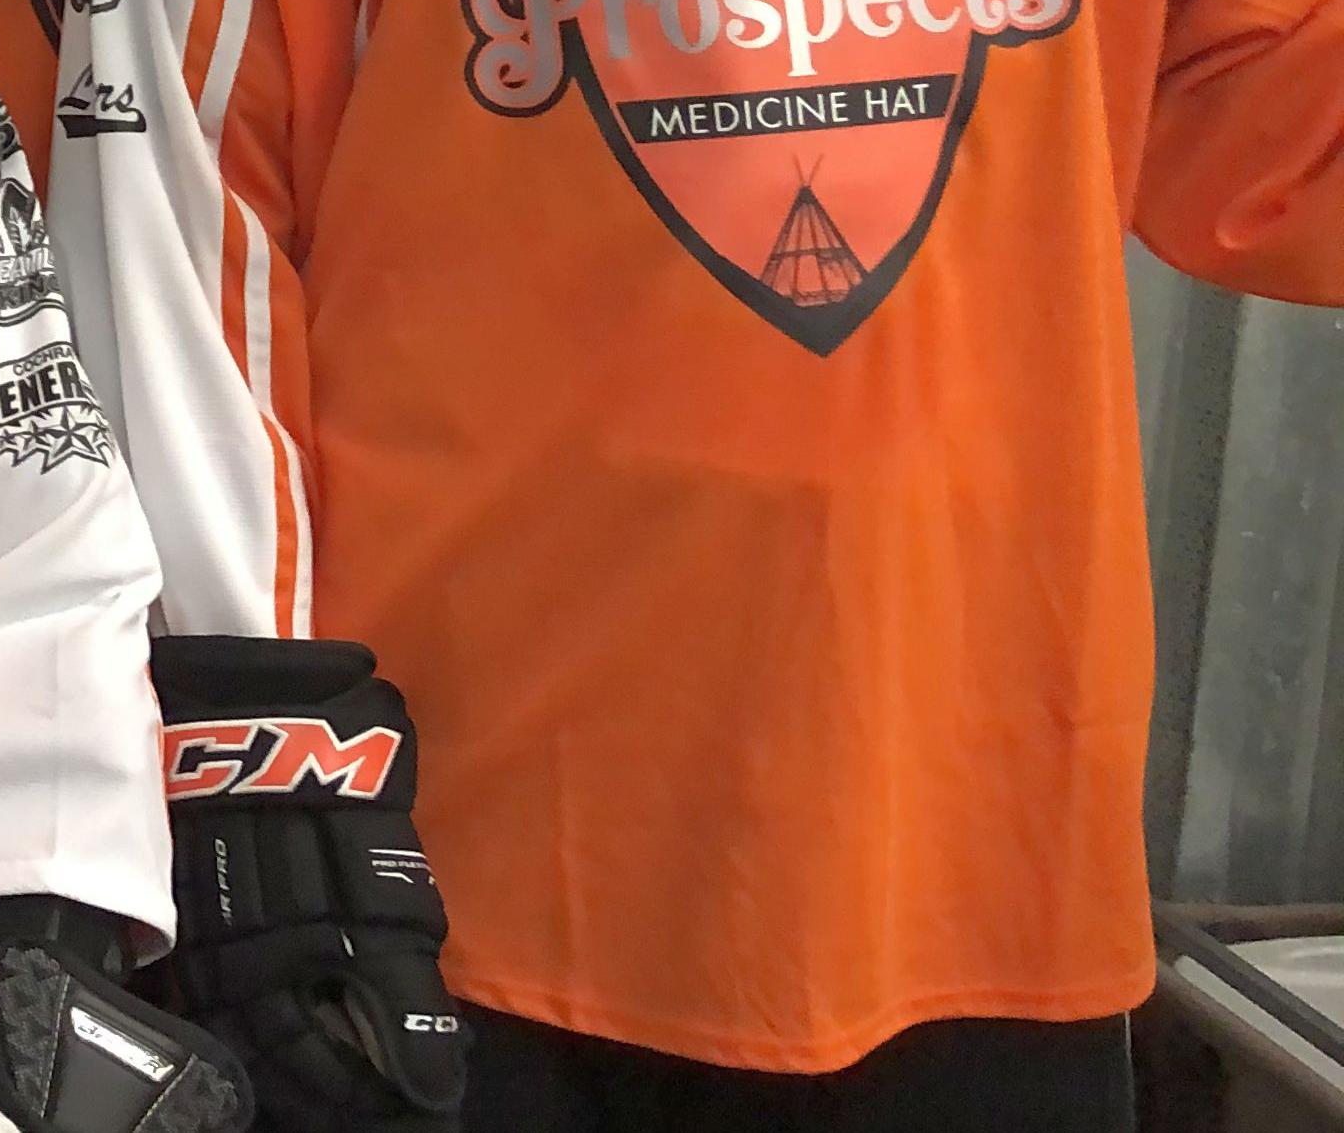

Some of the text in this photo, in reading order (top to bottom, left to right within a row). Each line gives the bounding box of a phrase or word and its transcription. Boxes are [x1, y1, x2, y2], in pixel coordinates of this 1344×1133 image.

[649, 83, 932, 139] MEDICINE HAT
[13, 346, 75, 376] COCHRA
[164, 717, 404, 801] CM
